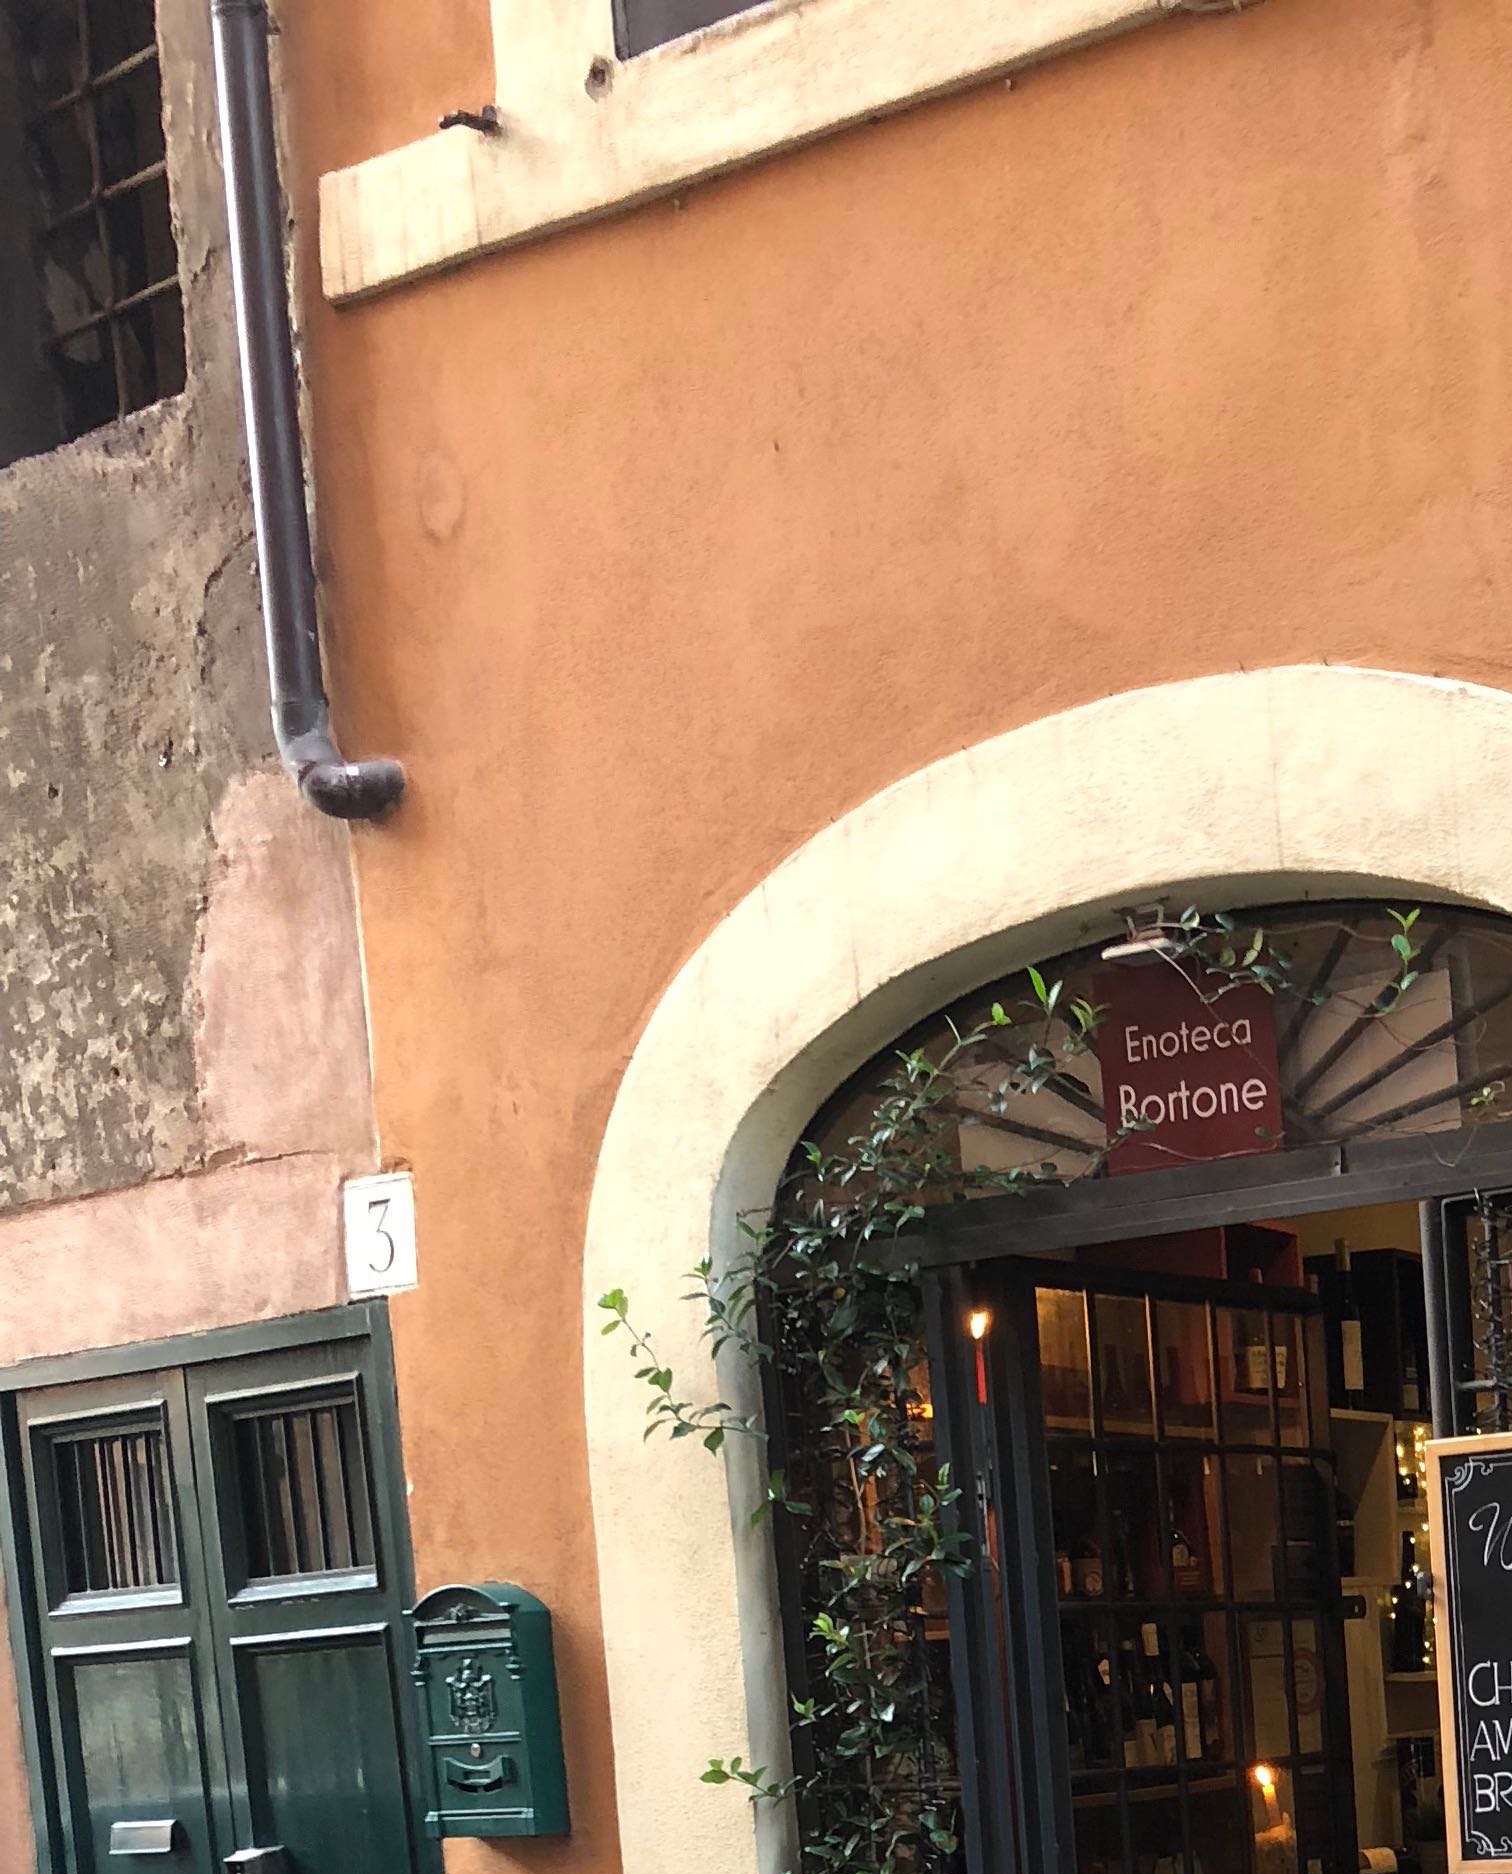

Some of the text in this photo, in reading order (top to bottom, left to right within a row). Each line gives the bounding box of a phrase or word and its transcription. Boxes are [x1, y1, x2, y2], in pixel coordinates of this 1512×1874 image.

[1124, 1018, 1252, 1063] Enoteca
[1118, 1077, 1268, 1129] Bortone
[367, 1197, 395, 1273] 3
